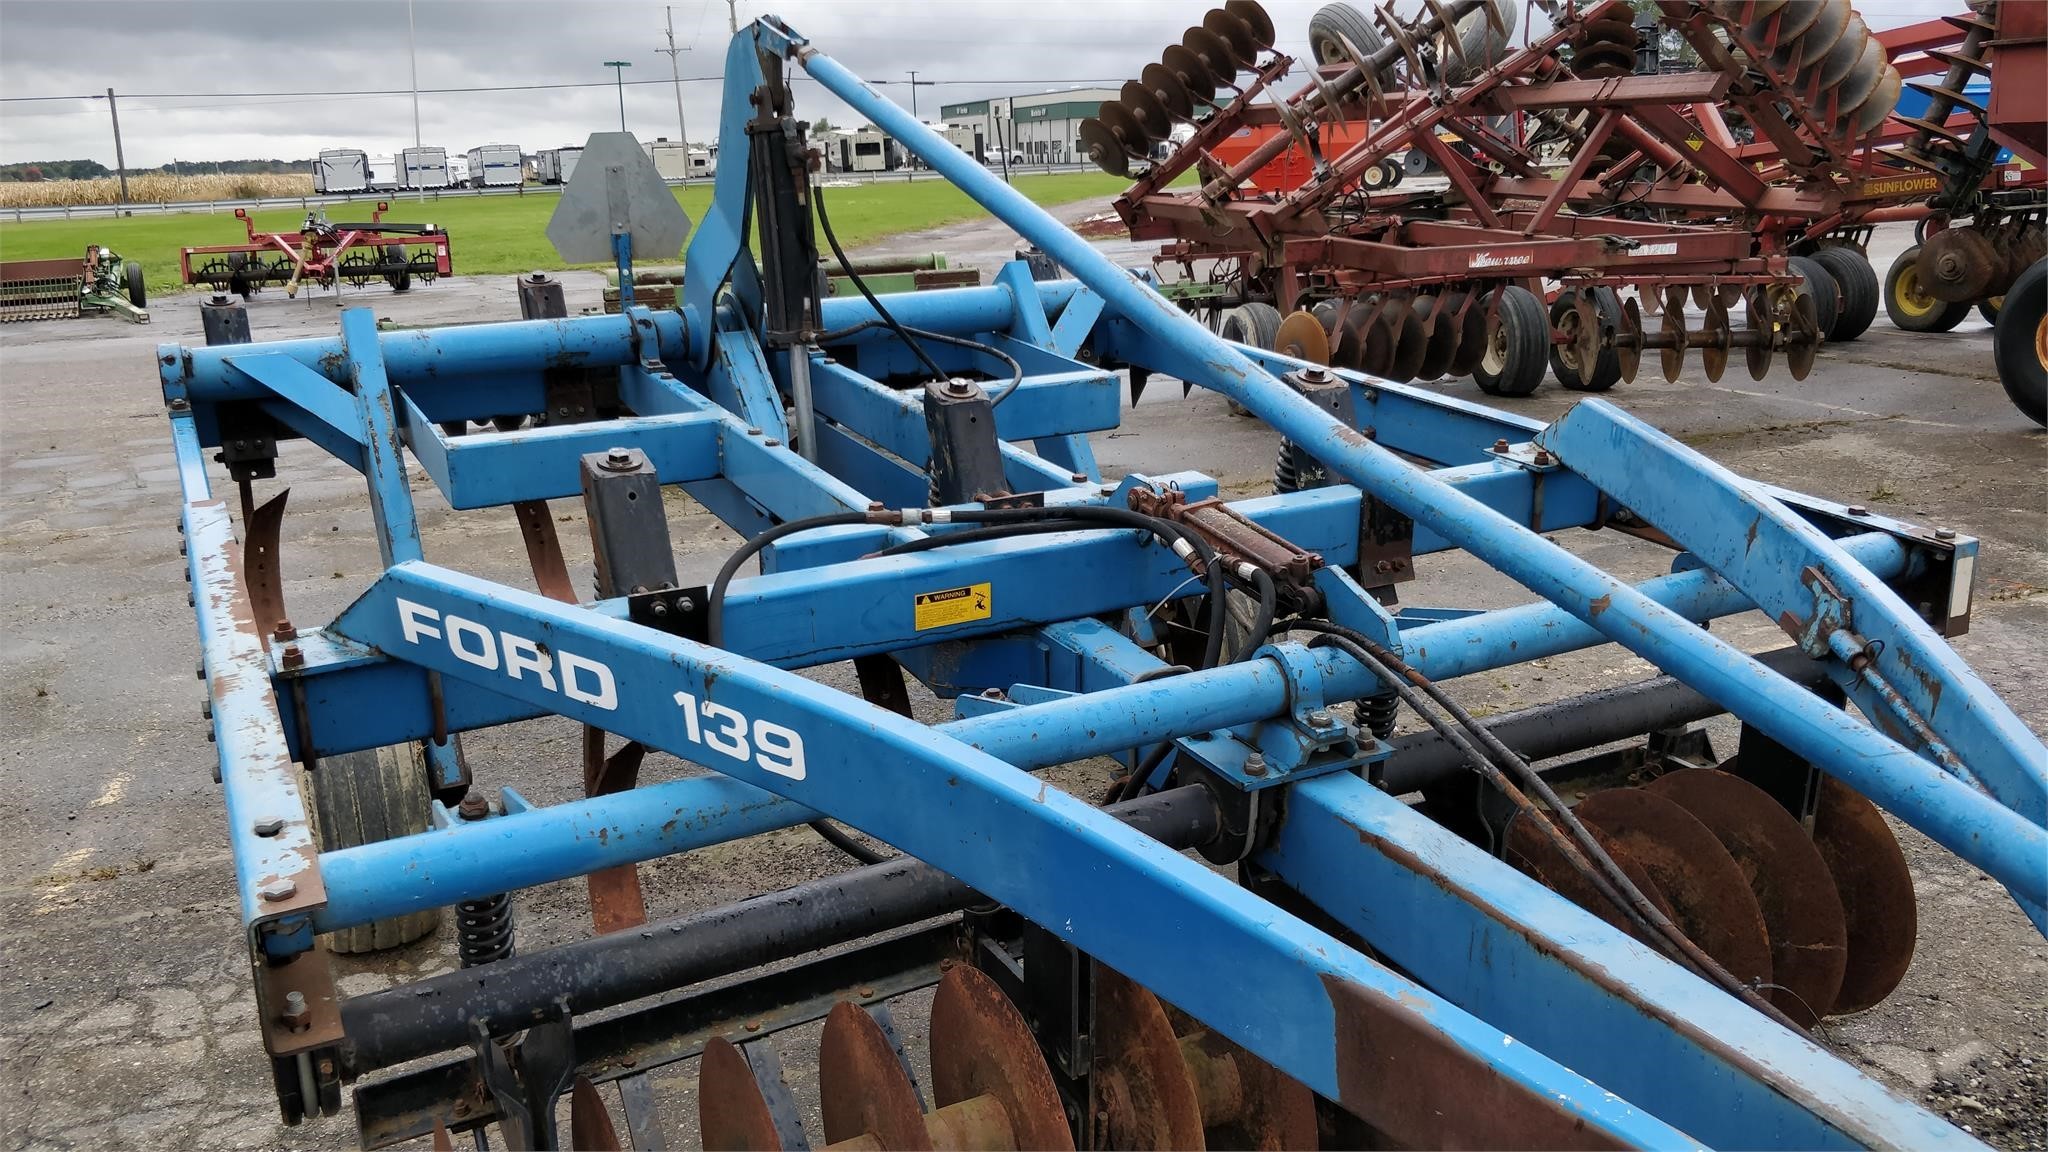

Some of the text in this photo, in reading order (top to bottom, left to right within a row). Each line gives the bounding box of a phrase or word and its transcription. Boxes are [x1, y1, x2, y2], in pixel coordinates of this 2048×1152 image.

[1873, 177, 1937, 195] SUNFLOWER
[934, 590, 966, 601] WARNING
[396, 597, 807, 781] FORD 139
